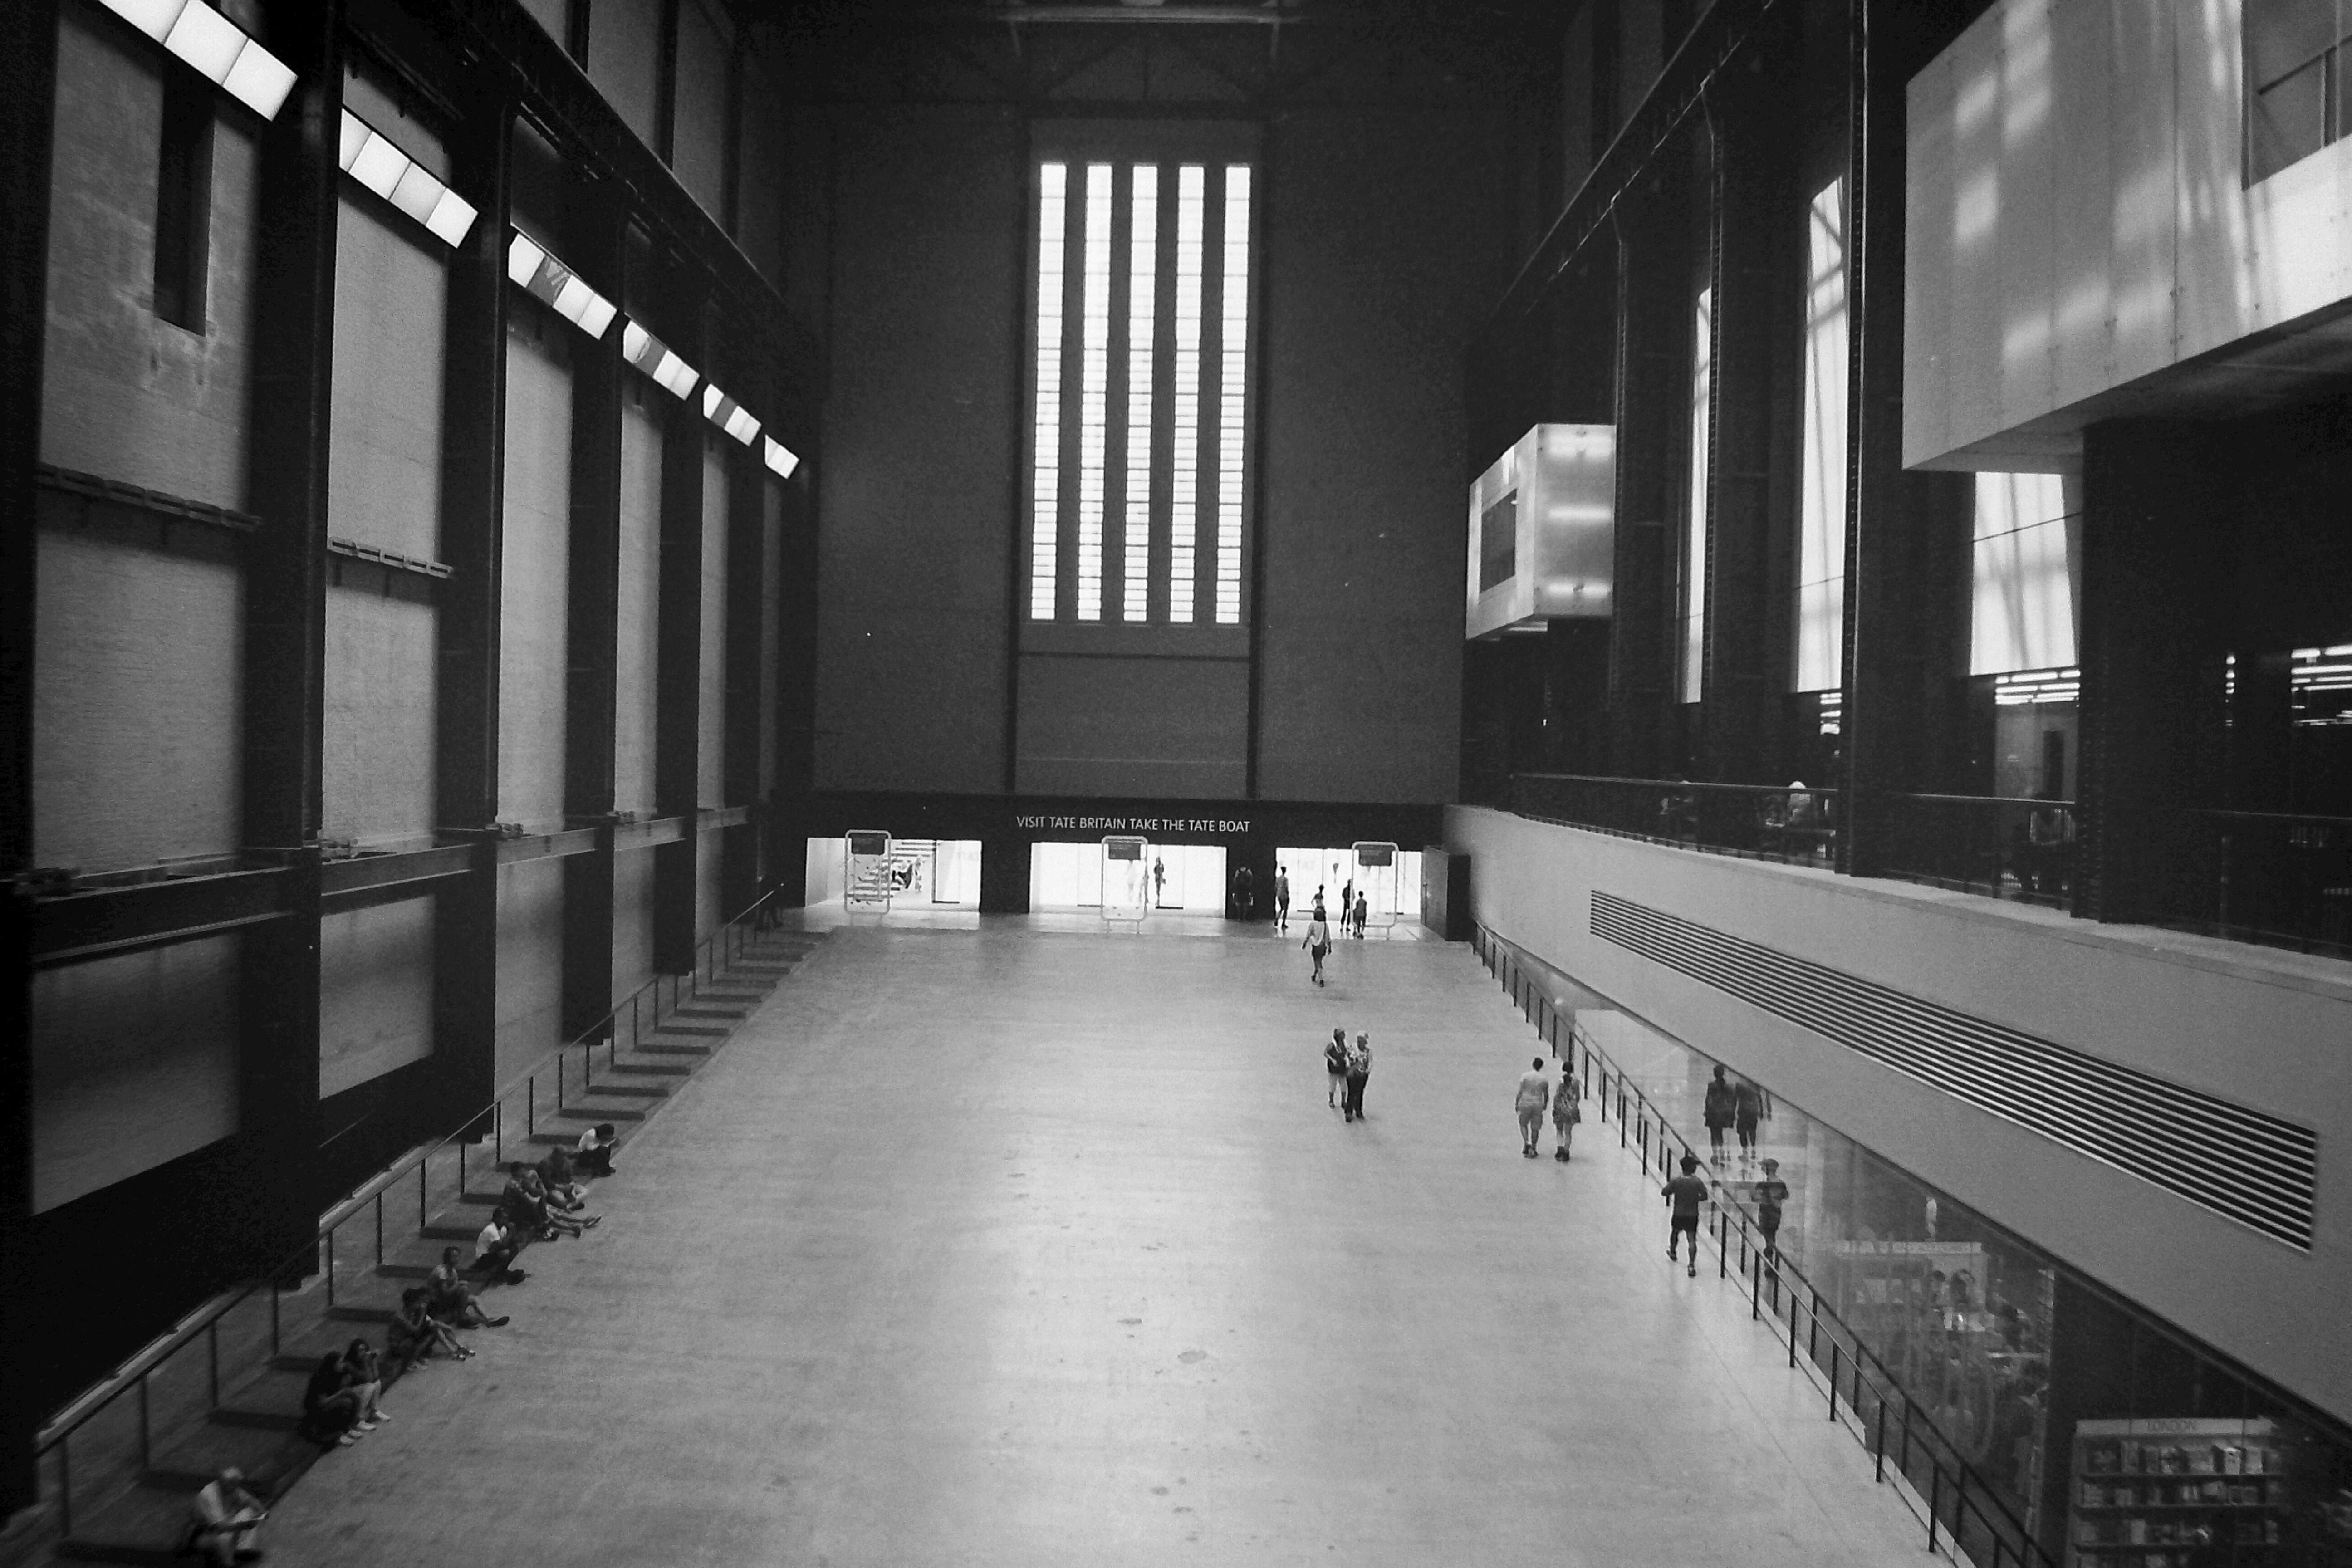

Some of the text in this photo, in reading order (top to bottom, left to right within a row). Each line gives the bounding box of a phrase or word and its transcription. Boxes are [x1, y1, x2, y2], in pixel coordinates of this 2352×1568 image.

[1016, 816, 1250, 832] VISIT TATE BRITAIN TAKE THE TATE BOAT
